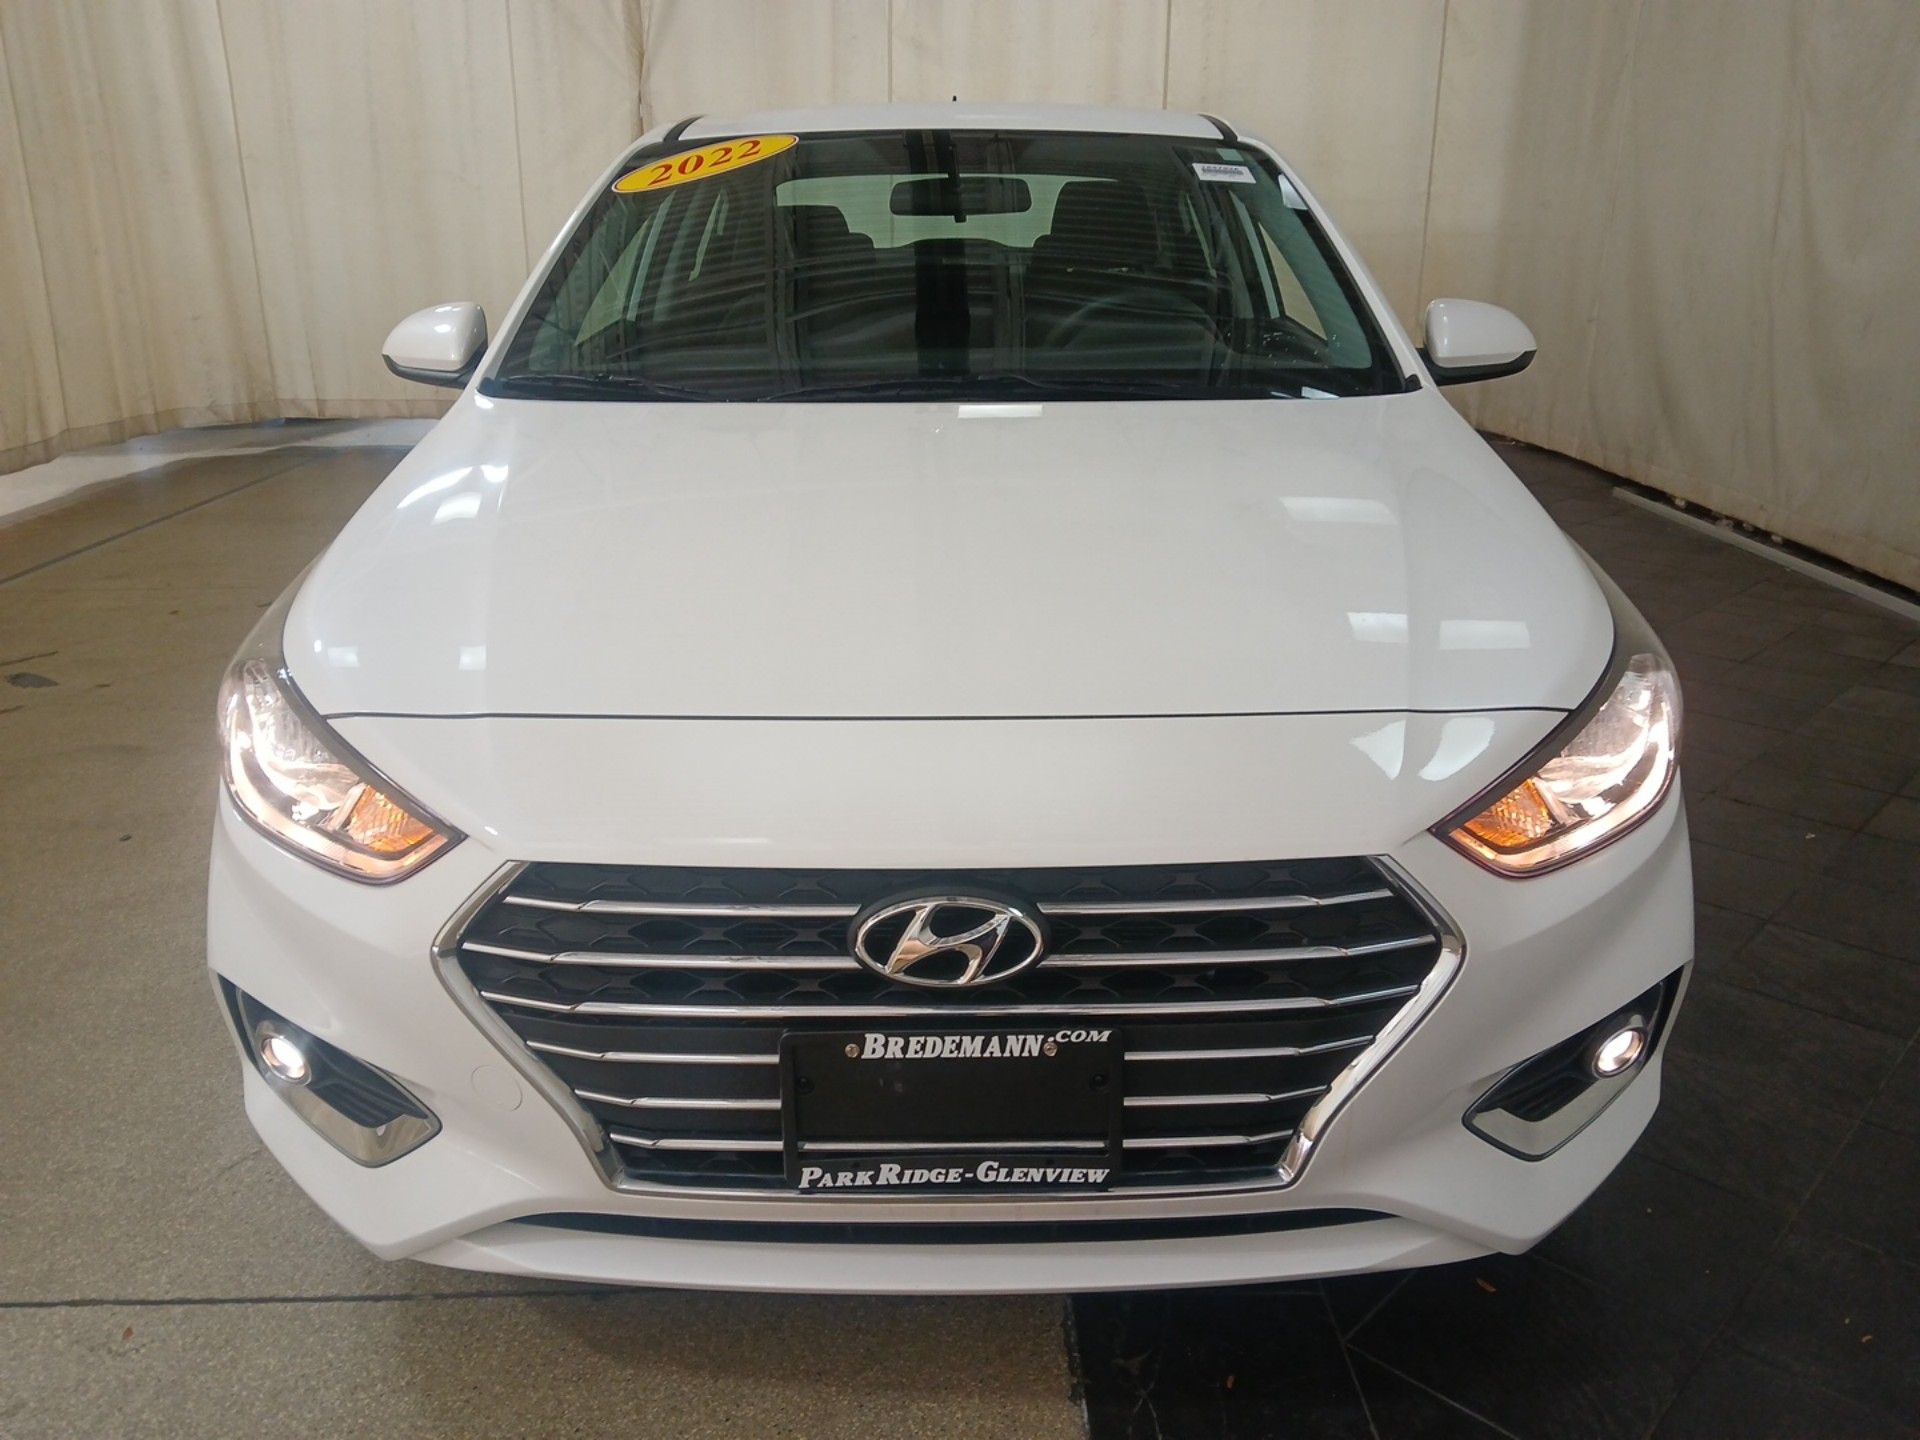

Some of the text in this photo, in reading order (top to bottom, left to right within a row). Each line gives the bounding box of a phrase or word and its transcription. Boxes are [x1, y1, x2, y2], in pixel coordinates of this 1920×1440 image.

[648, 139, 761, 186] 2022
[798, 1161, 1109, 1189] PARK RIDGE-GLENVIEW
